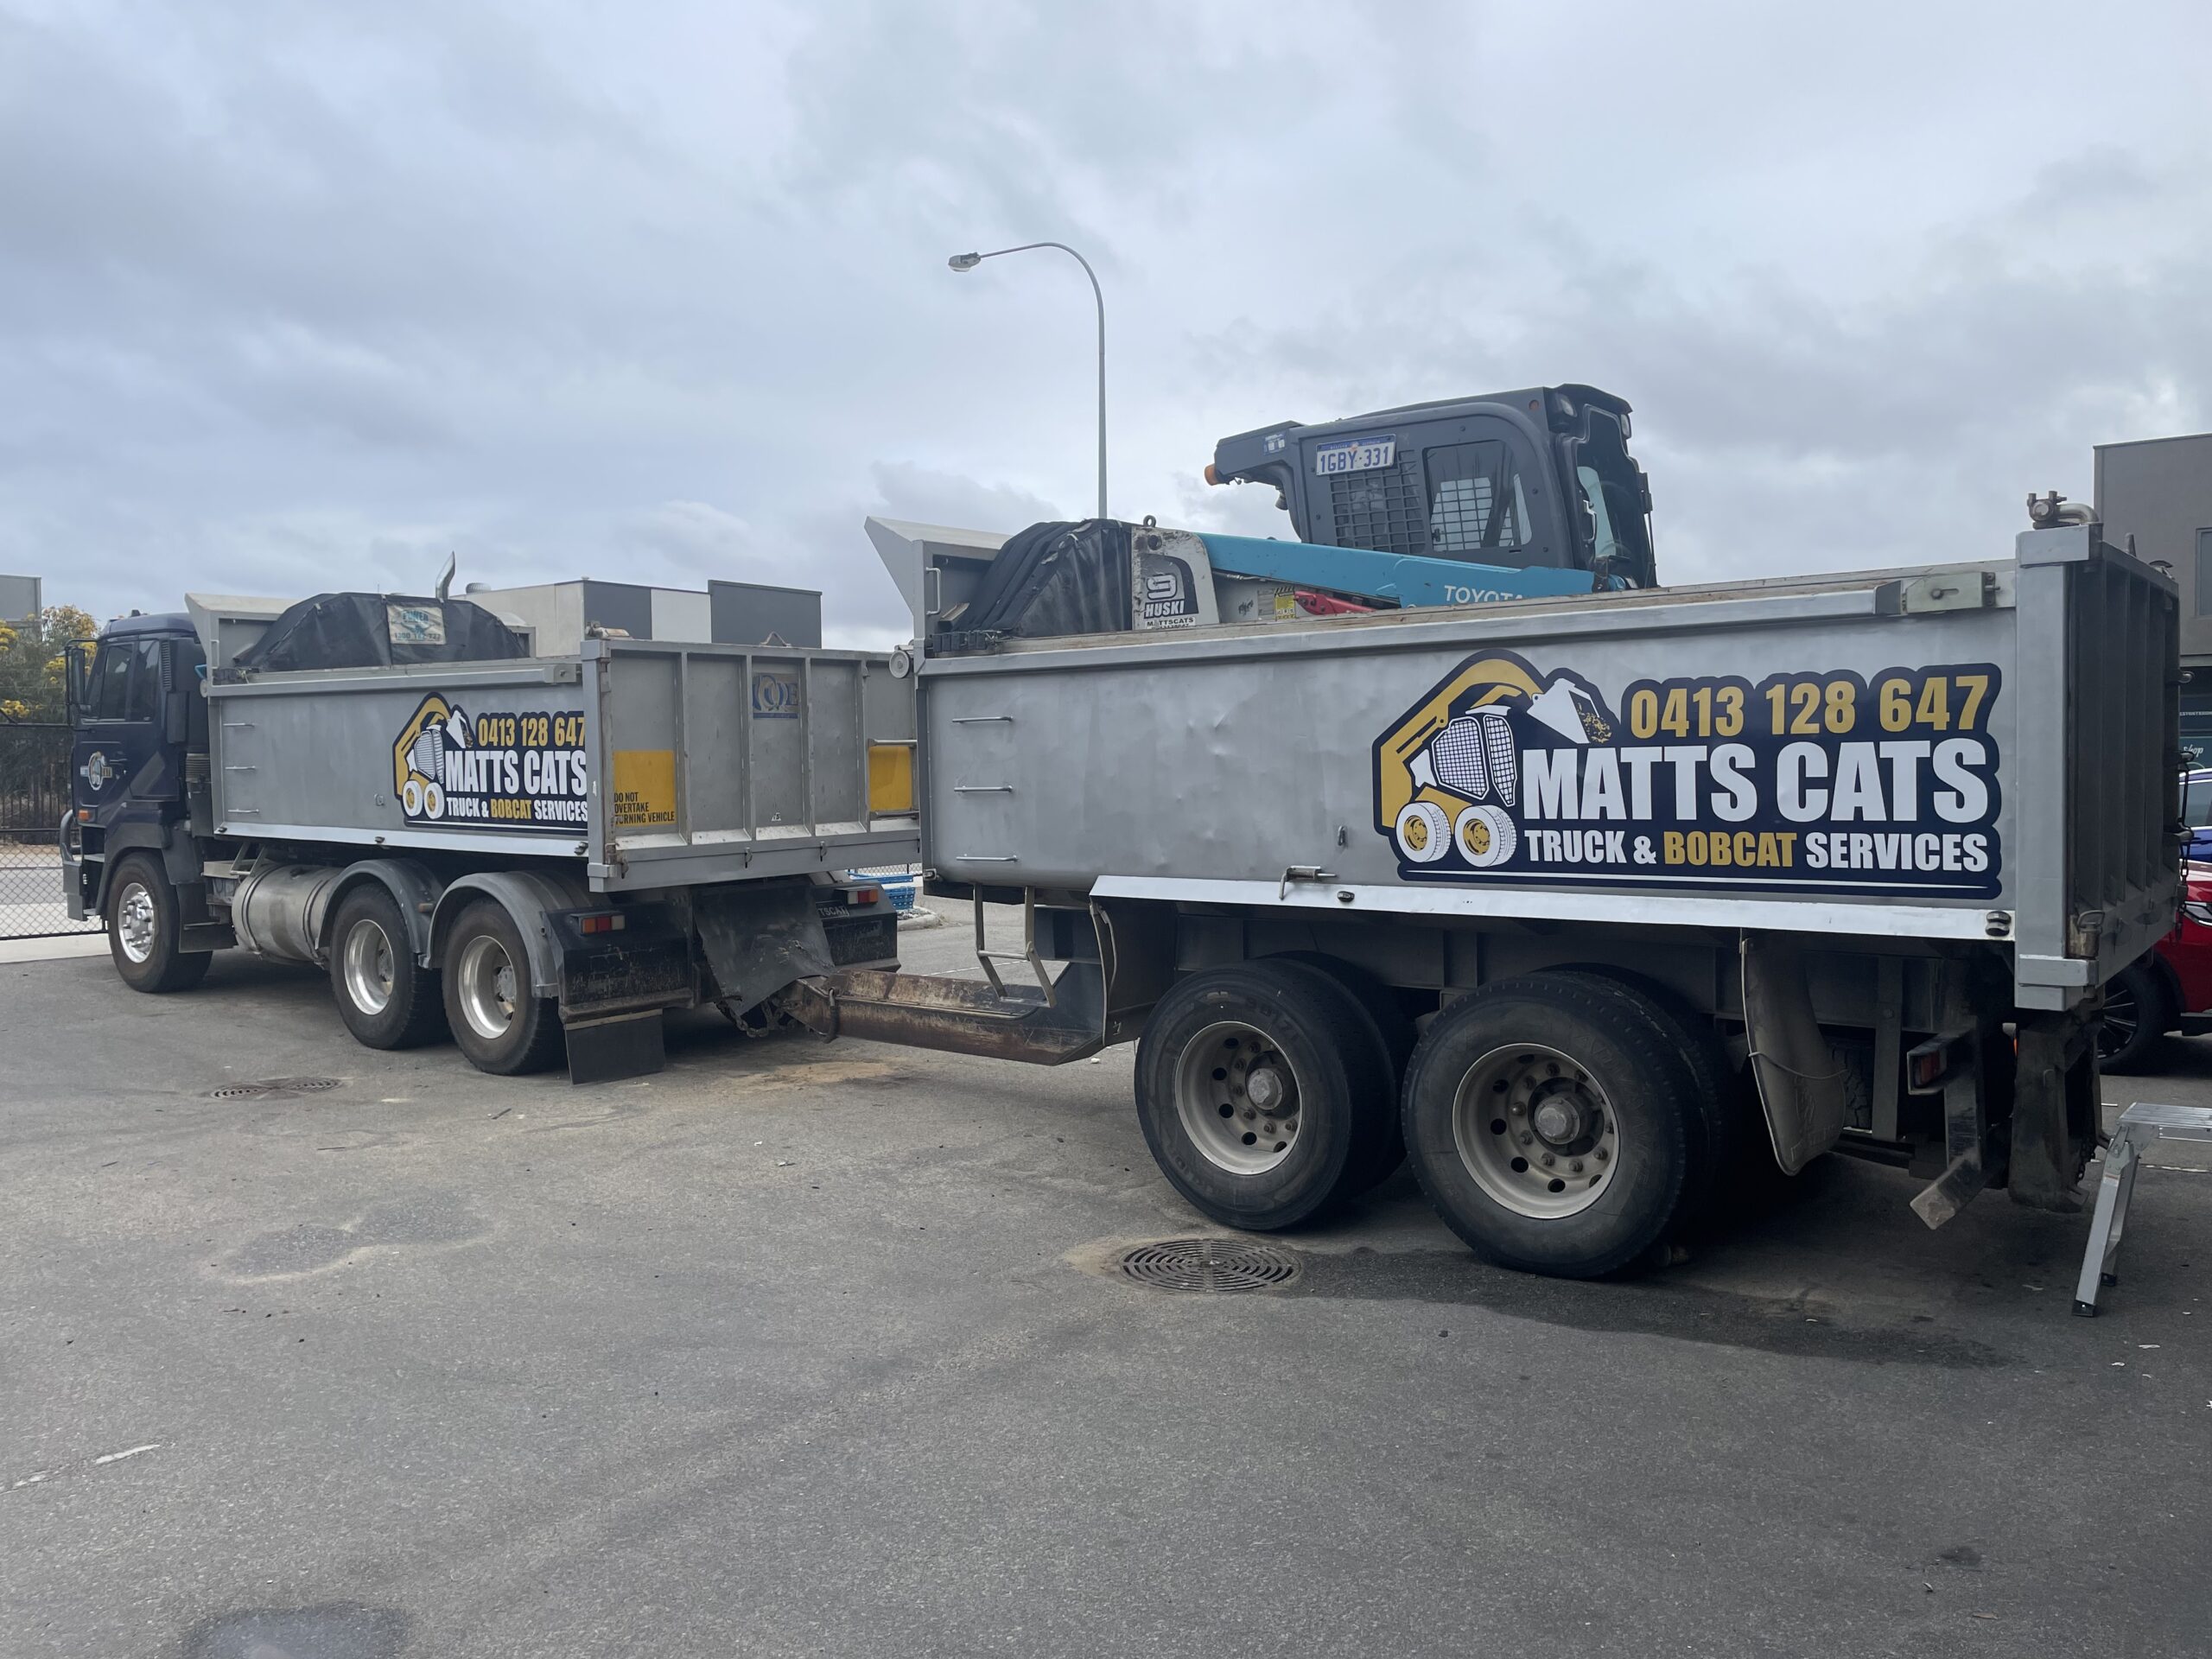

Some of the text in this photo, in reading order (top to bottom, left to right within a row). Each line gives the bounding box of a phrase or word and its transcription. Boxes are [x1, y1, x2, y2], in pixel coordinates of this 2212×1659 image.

[1444, 584, 1523, 603] TOYOT
[1145, 600, 1185, 618] HUSKI
[1147, 617, 1194, 626] MTTSCATS
[1630, 674, 1990, 740] 0413 128 647
[478, 716, 586, 747] 0413 128 647
[444, 749, 587, 797] MATTS CATS
[1522, 737, 1990, 824] MATTS CATS
[613, 791, 639, 803] DO NOT
[614, 802, 650, 814] OVERTAKE
[446, 797, 588, 822] TRUCK & BOBCAT SERVICES
[648, 810, 676, 823] VEHICLE
[1524, 830, 1990, 873] TRUCK & BOBCAT SERVICES
